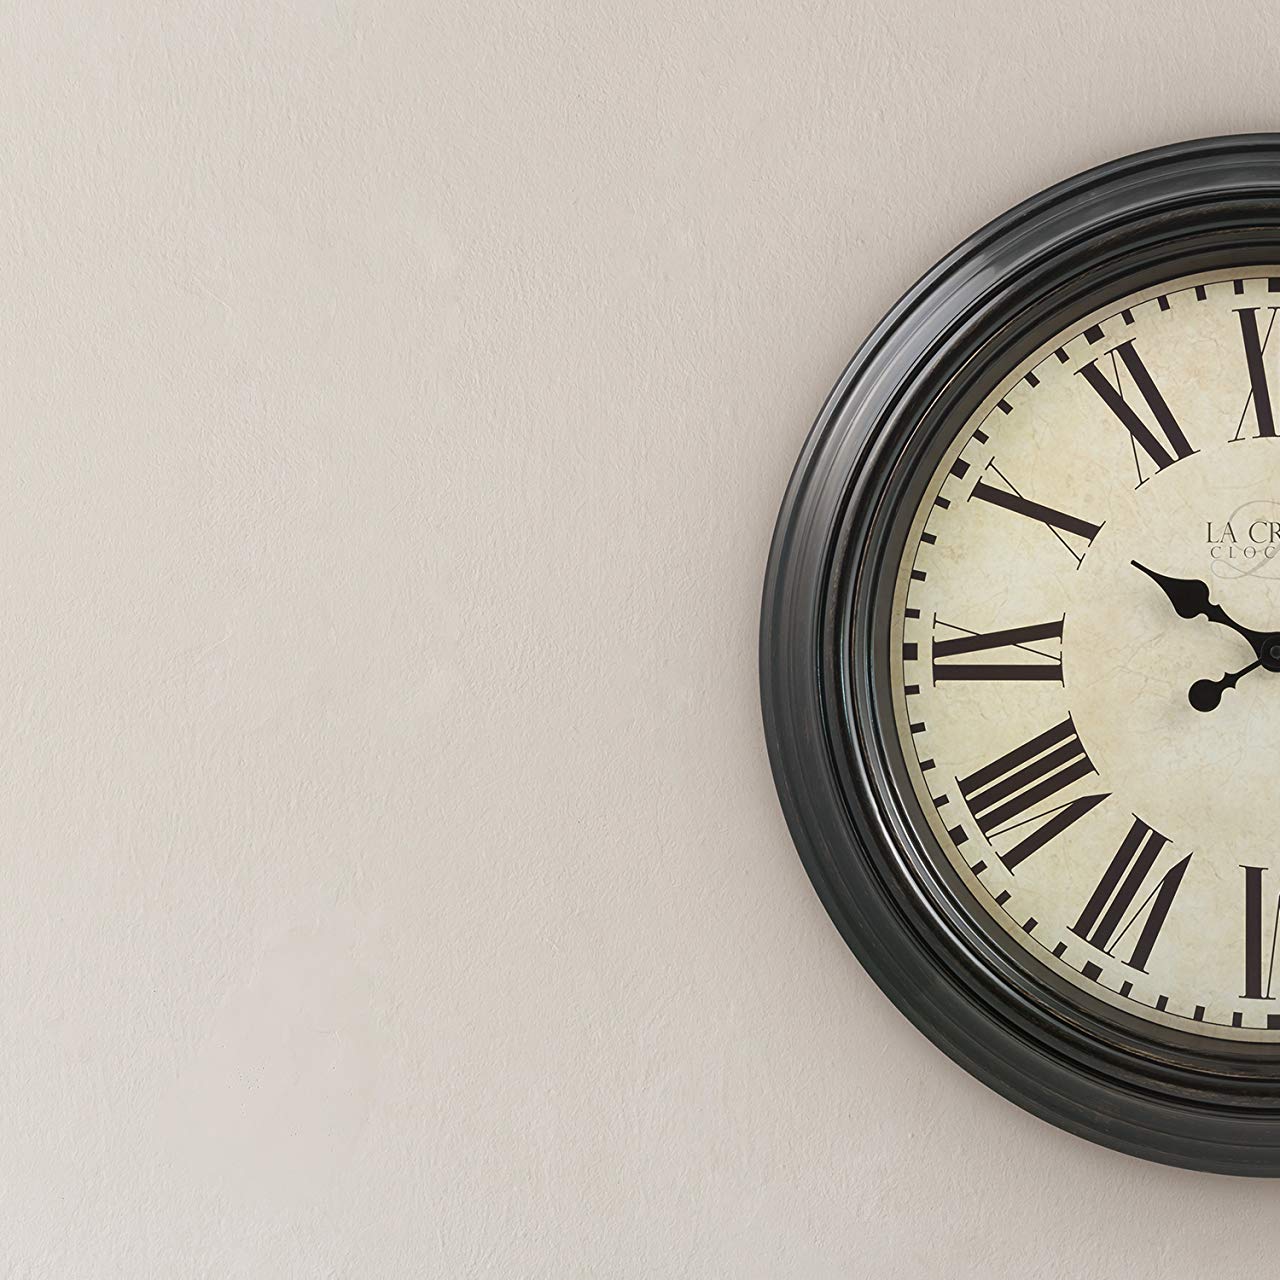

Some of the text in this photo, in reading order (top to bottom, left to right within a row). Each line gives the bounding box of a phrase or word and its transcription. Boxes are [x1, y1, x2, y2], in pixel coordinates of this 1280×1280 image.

[1073, 337, 1200, 490] XI
[967, 456, 1106, 570] X
[1206, 521, 1237, 544] LA
[932, 612, 1065, 688] IX
[955, 712, 1112, 876] VIII
[1066, 813, 1193, 975] VII
